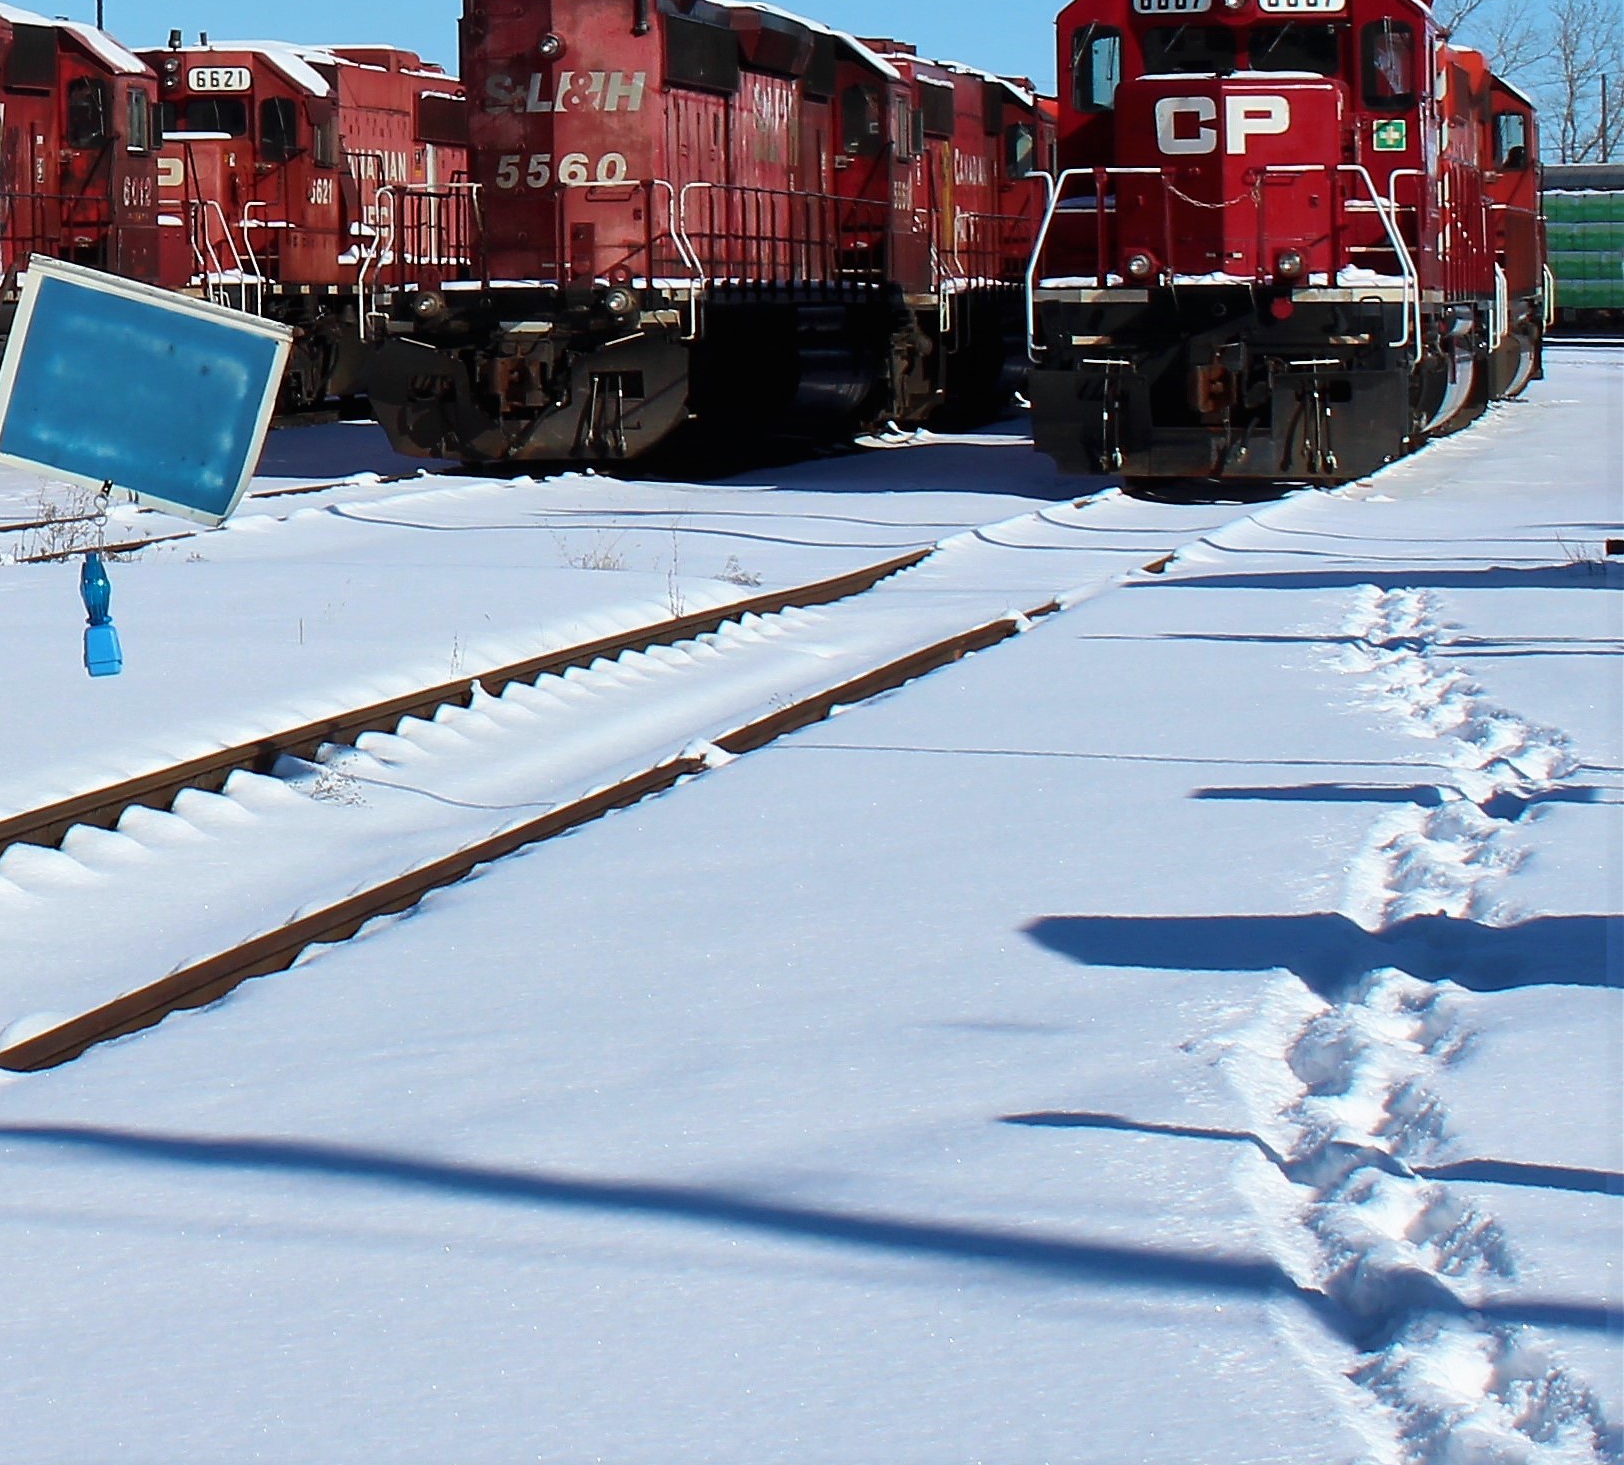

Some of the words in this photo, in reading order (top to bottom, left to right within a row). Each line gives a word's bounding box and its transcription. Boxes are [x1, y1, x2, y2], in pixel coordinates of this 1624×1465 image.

[195, 70, 243, 88] 6621
[1155, 95, 1290, 155] CP
[495, 152, 627, 189] 5560
